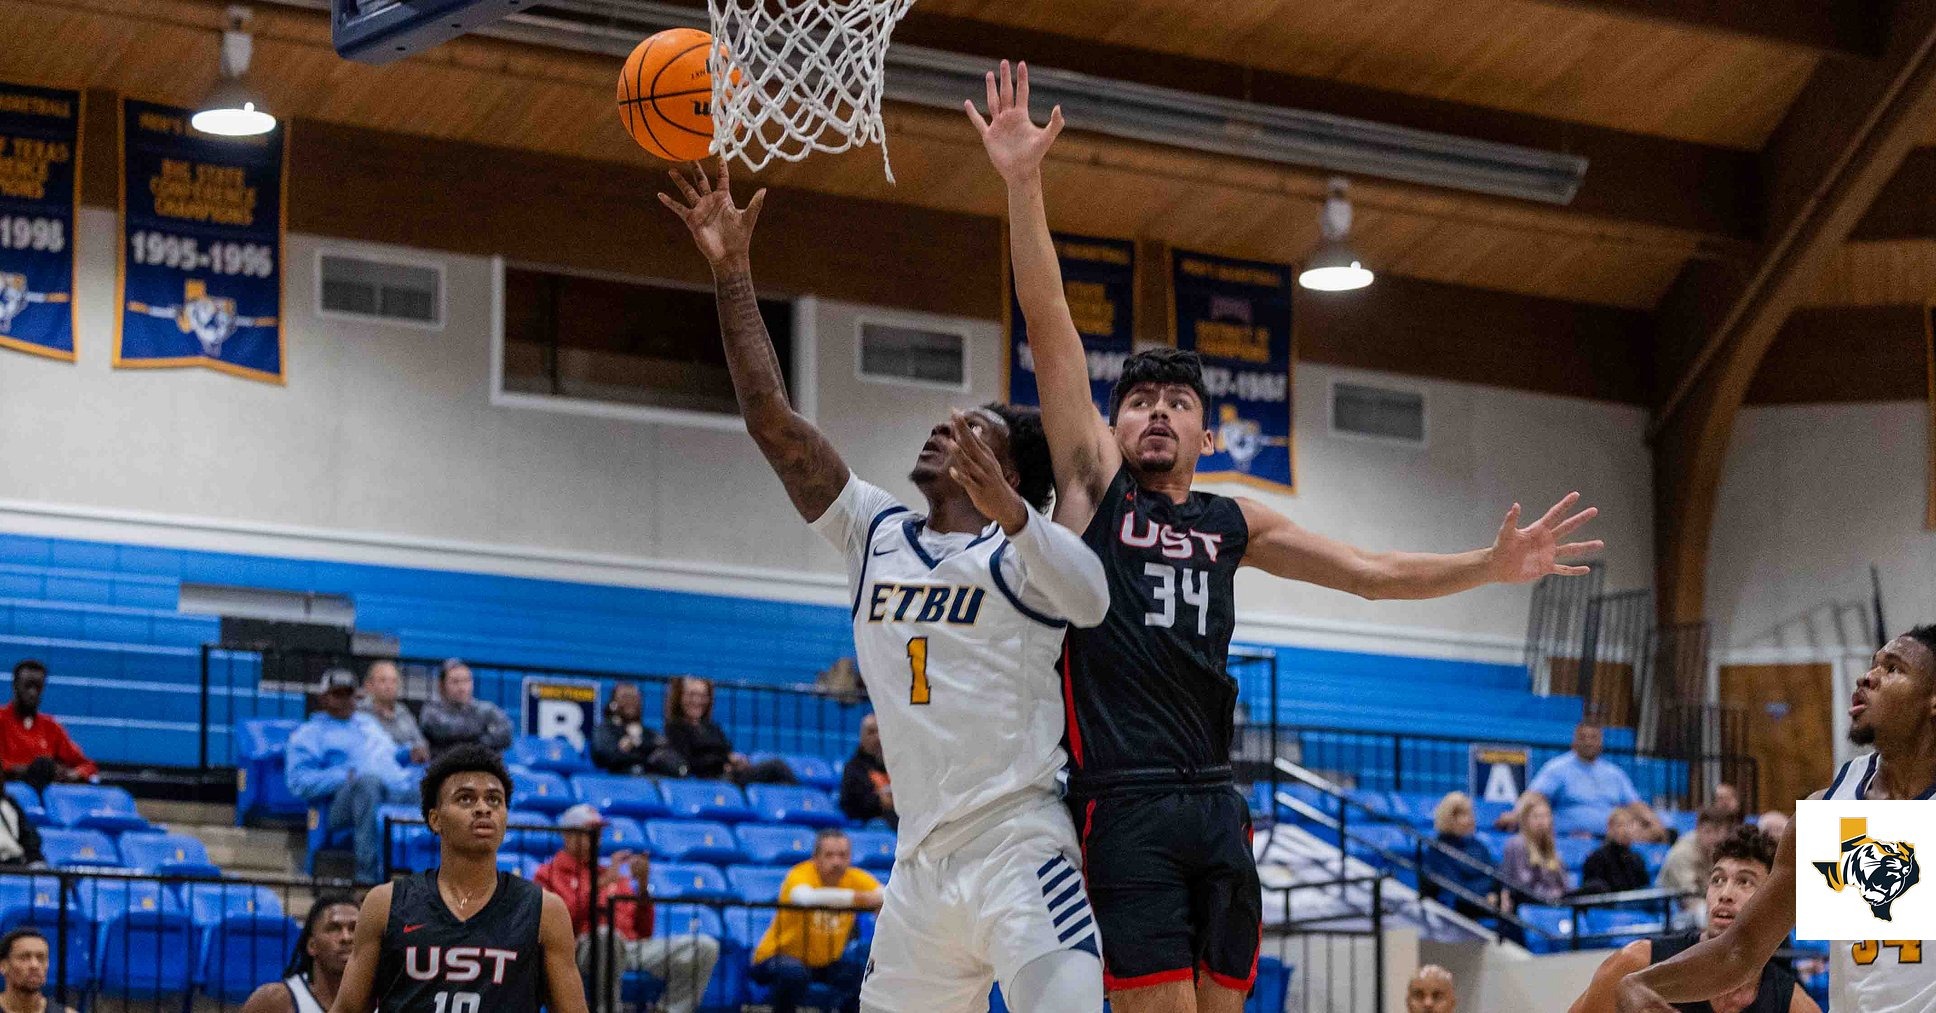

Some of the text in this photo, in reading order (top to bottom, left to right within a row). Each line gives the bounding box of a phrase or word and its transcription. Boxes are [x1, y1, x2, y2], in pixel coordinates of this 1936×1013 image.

[131, 230, 273, 279] 1995-1996
[1119, 511, 1222, 563] UST
[868, 583, 987, 626] ETBU
[1143, 562, 1209, 636] 34
[906, 636, 932, 705] 1
[1484, 764, 1518, 802] A
[406, 945, 518, 985] UST
